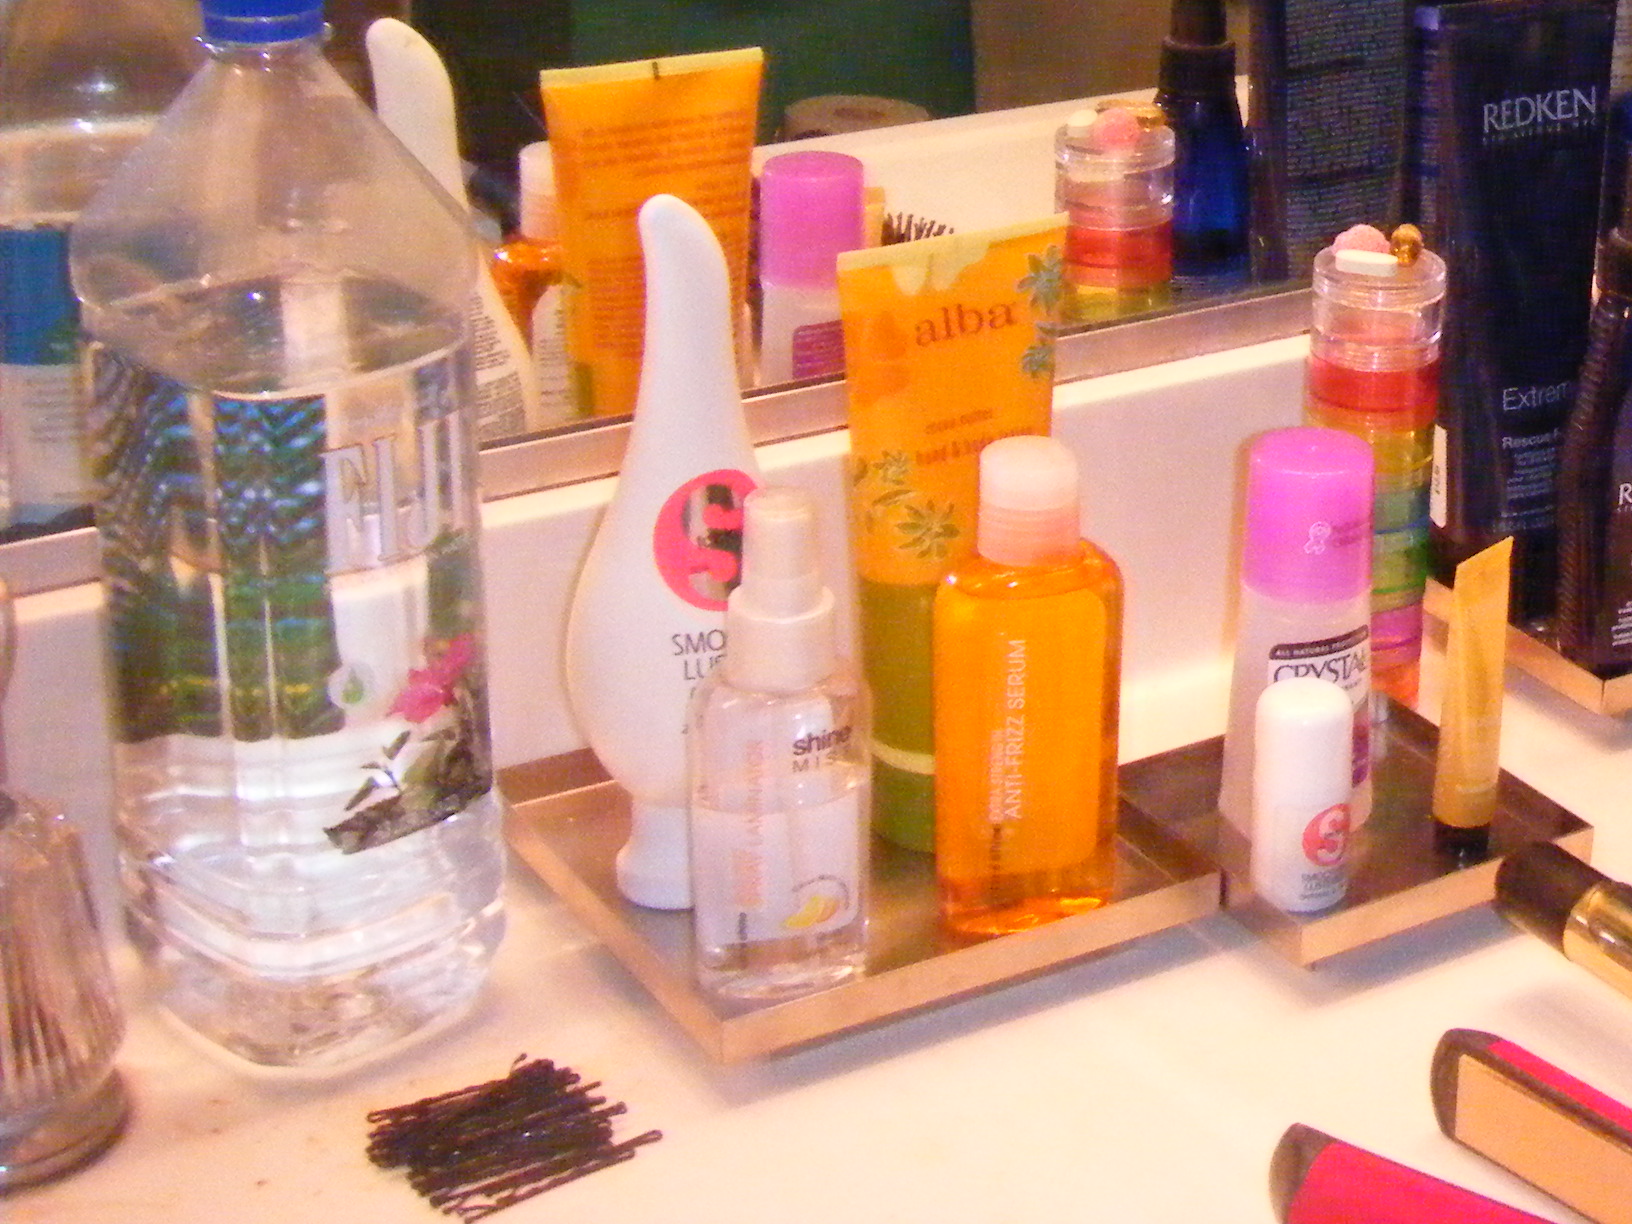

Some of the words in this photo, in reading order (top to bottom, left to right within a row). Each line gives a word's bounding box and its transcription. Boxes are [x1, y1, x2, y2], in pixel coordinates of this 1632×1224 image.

[1483, 85, 1597, 134] REDKEN
[915, 303, 1017, 347] alba
[1007, 639, 1027, 710] SERUM
[793, 725, 852, 756] shine
[1003, 715, 1025, 820] ANTI-FRIZZ
